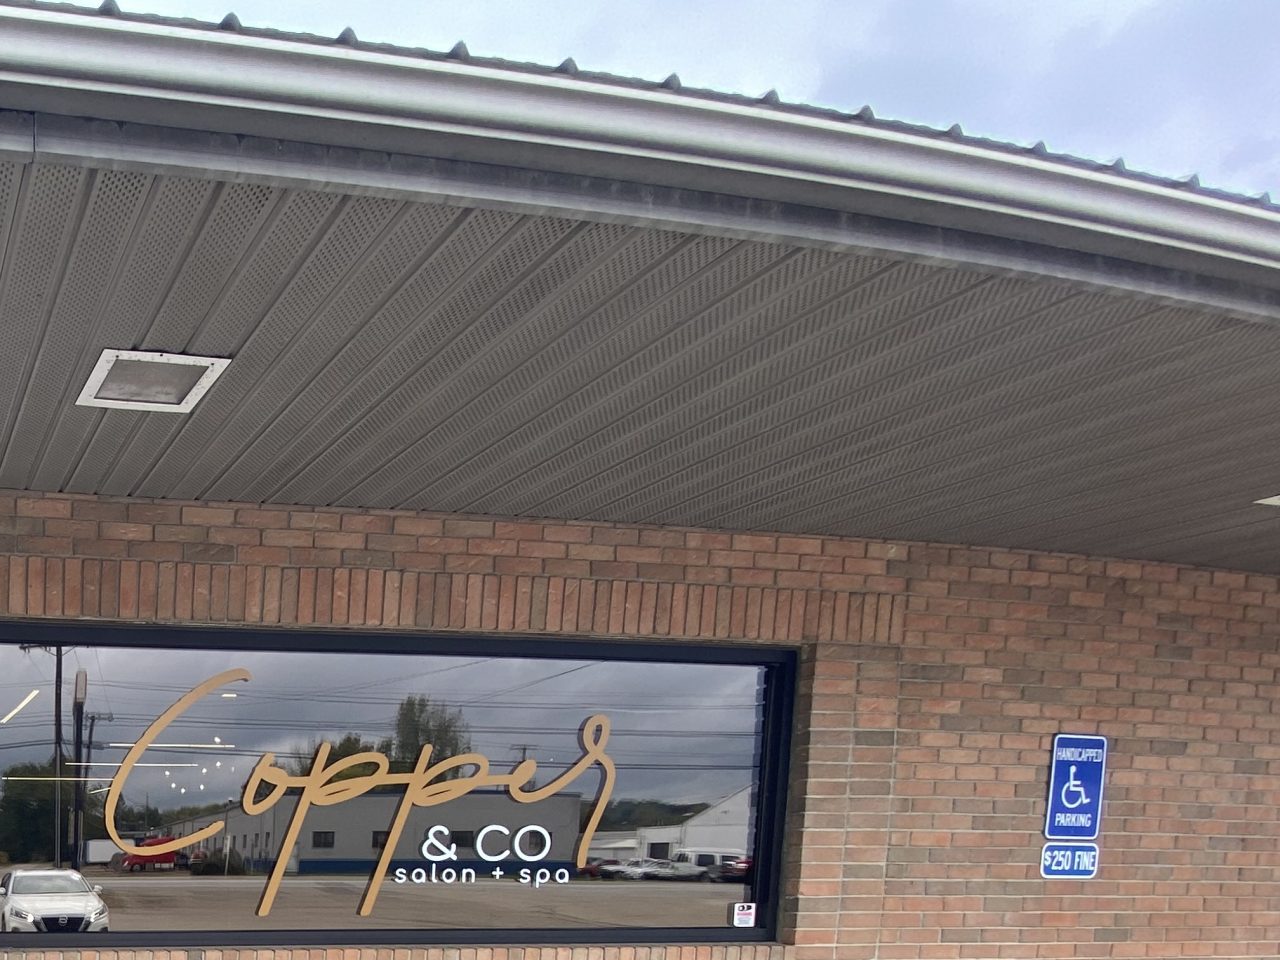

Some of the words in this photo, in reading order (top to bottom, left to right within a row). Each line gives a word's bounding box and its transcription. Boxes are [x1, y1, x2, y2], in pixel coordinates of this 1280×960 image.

[1056, 748, 1102, 762] HANDICAPPED
[106, 669, 616, 917] Copper
[1054, 813, 1092, 827] PARKING
[421, 824, 458, 862] &
[475, 824, 552, 862] CO
[1044, 850, 1072, 870] $250
[1074, 851, 1096, 871] FINE
[395, 863, 476, 885] salon
[492, 866, 504, 880] +
[519, 866, 571, 888] spa
